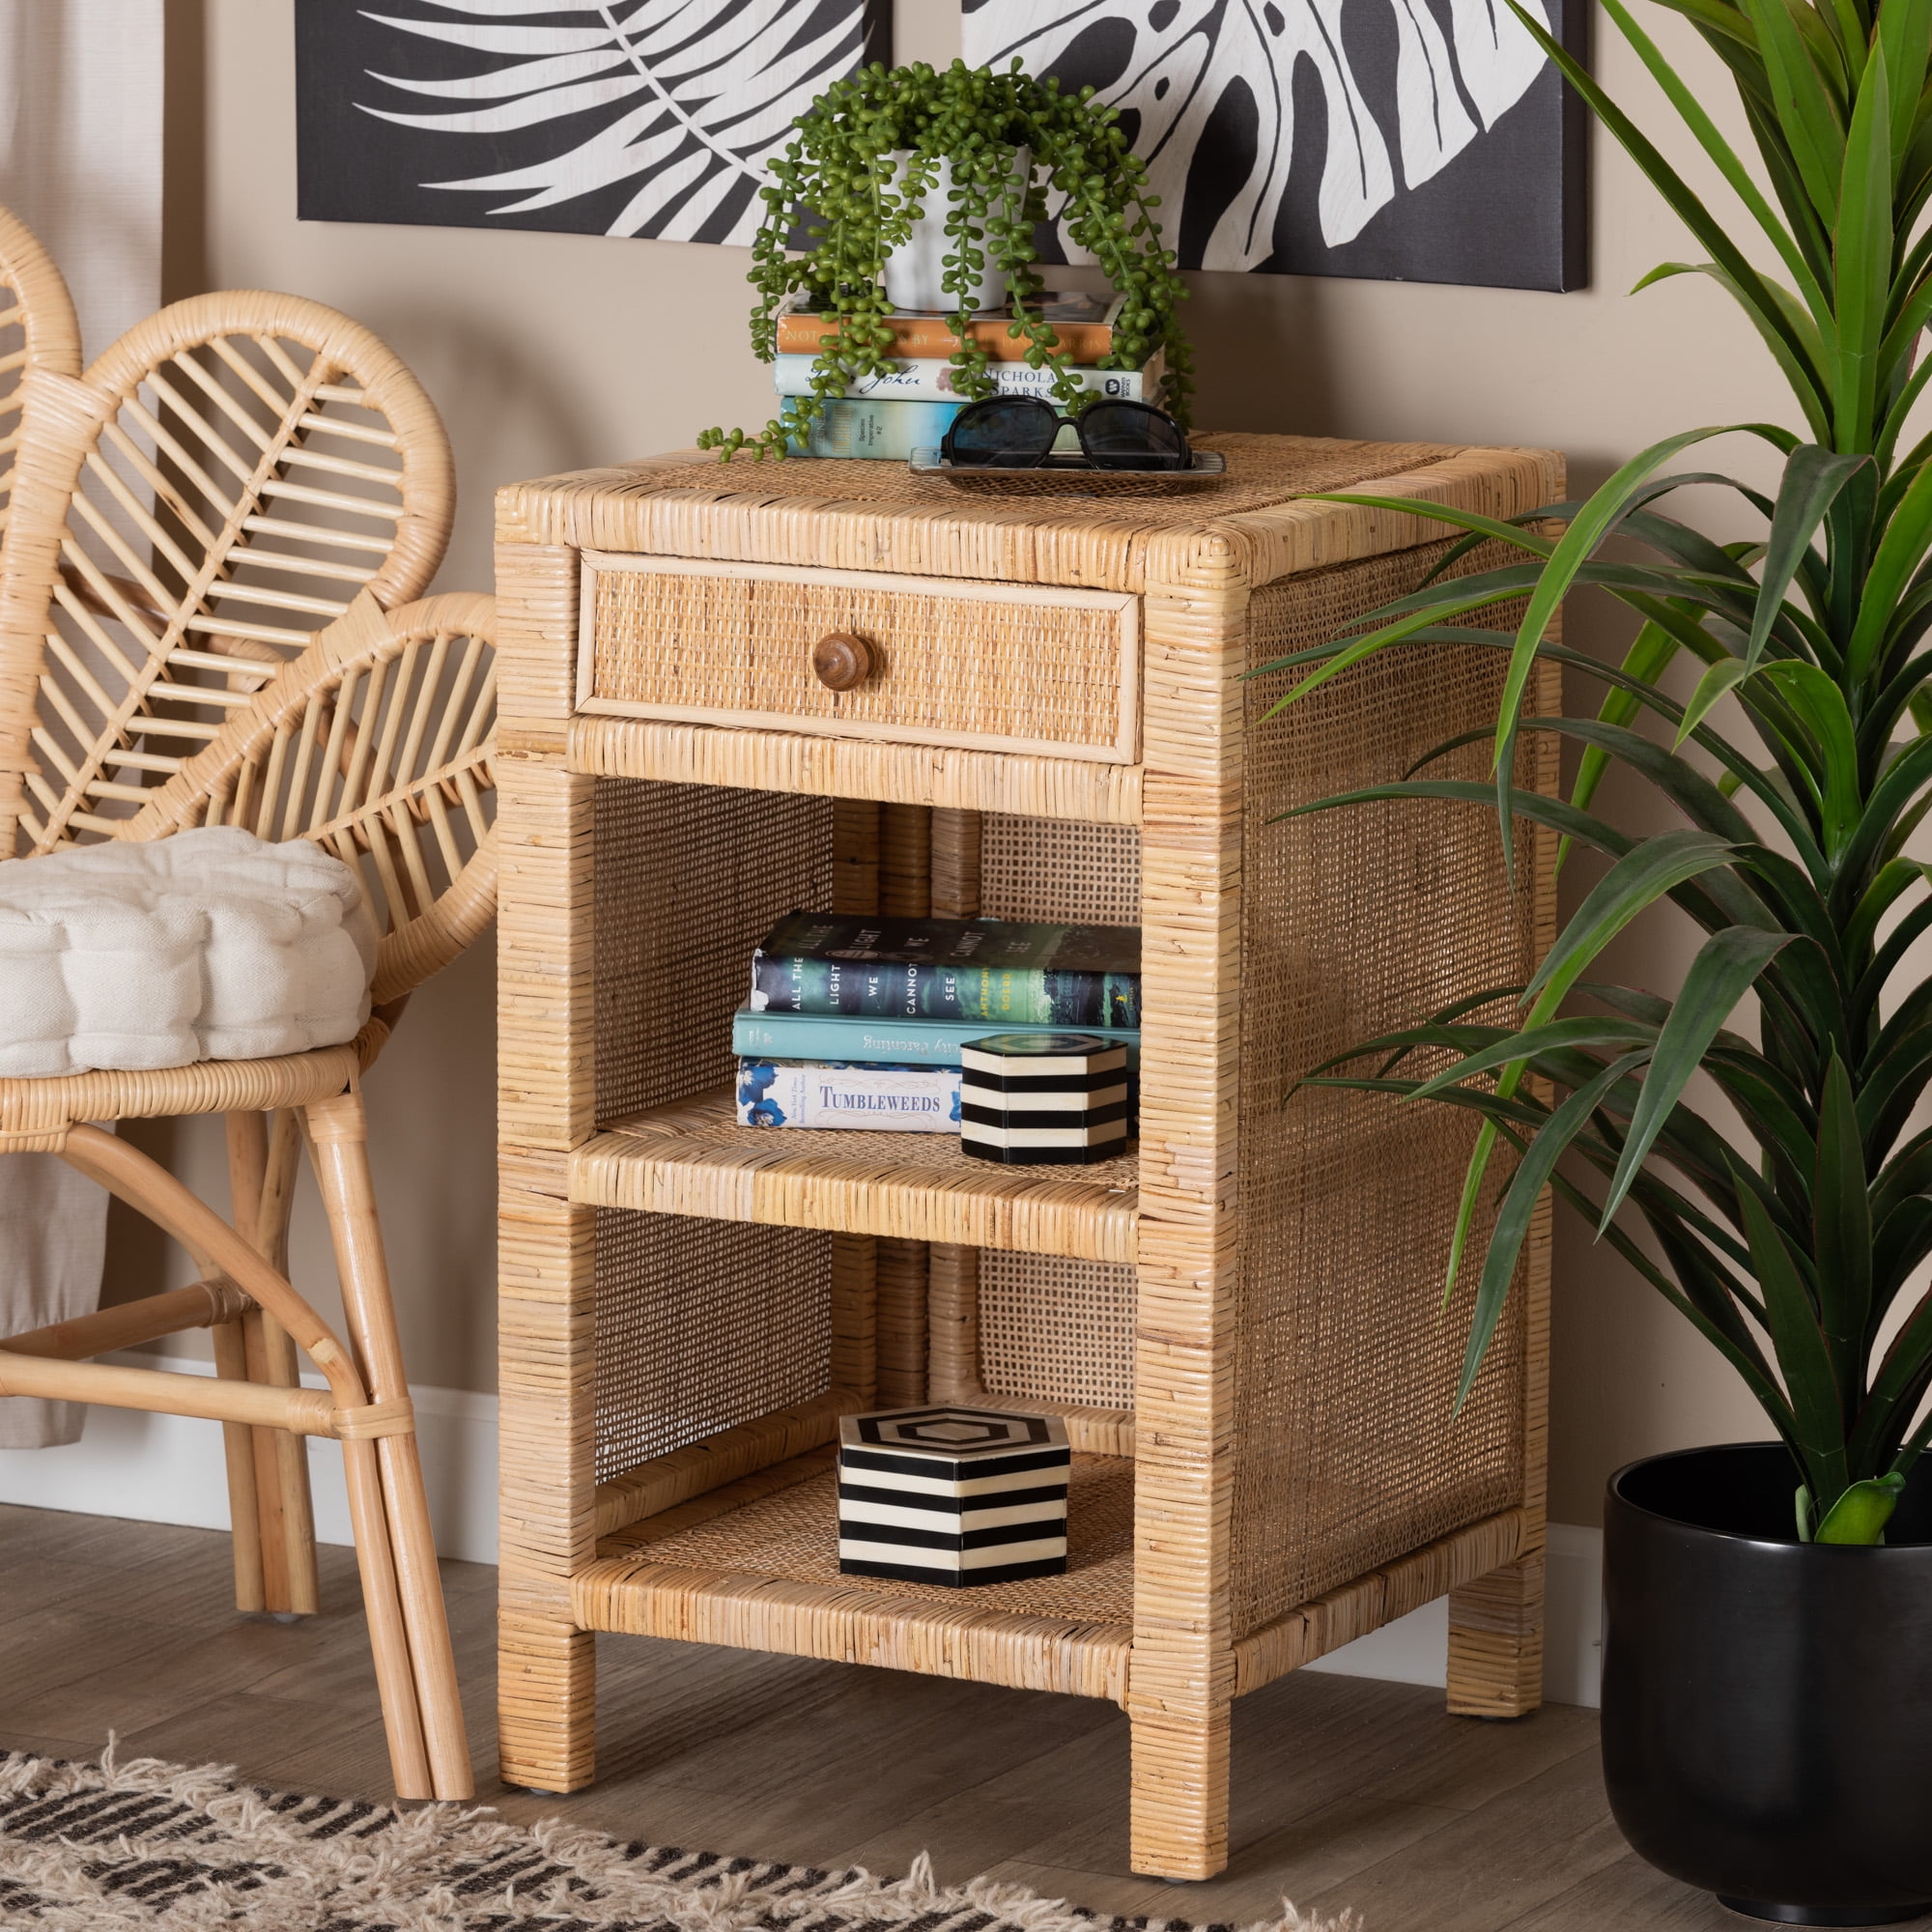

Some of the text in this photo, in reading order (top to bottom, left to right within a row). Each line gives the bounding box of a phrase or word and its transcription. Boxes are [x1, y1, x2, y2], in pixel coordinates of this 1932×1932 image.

[785, 329, 819, 342] NOT
[1059, 338, 1102, 350] ARRIS
[980, 368, 1057, 384] NICHOLA
[989, 383, 1053, 399] SPARKS
[791, 957, 804, 1010] ALL THE
[830, 964, 840, 1006] LIGHT
[867, 977, 878, 997] WE
[945, 977, 955, 1002] SEE
[863, 1035, 930, 1056] Parenting
[819, 1086, 941, 1113] TUMBLEWEEDS
